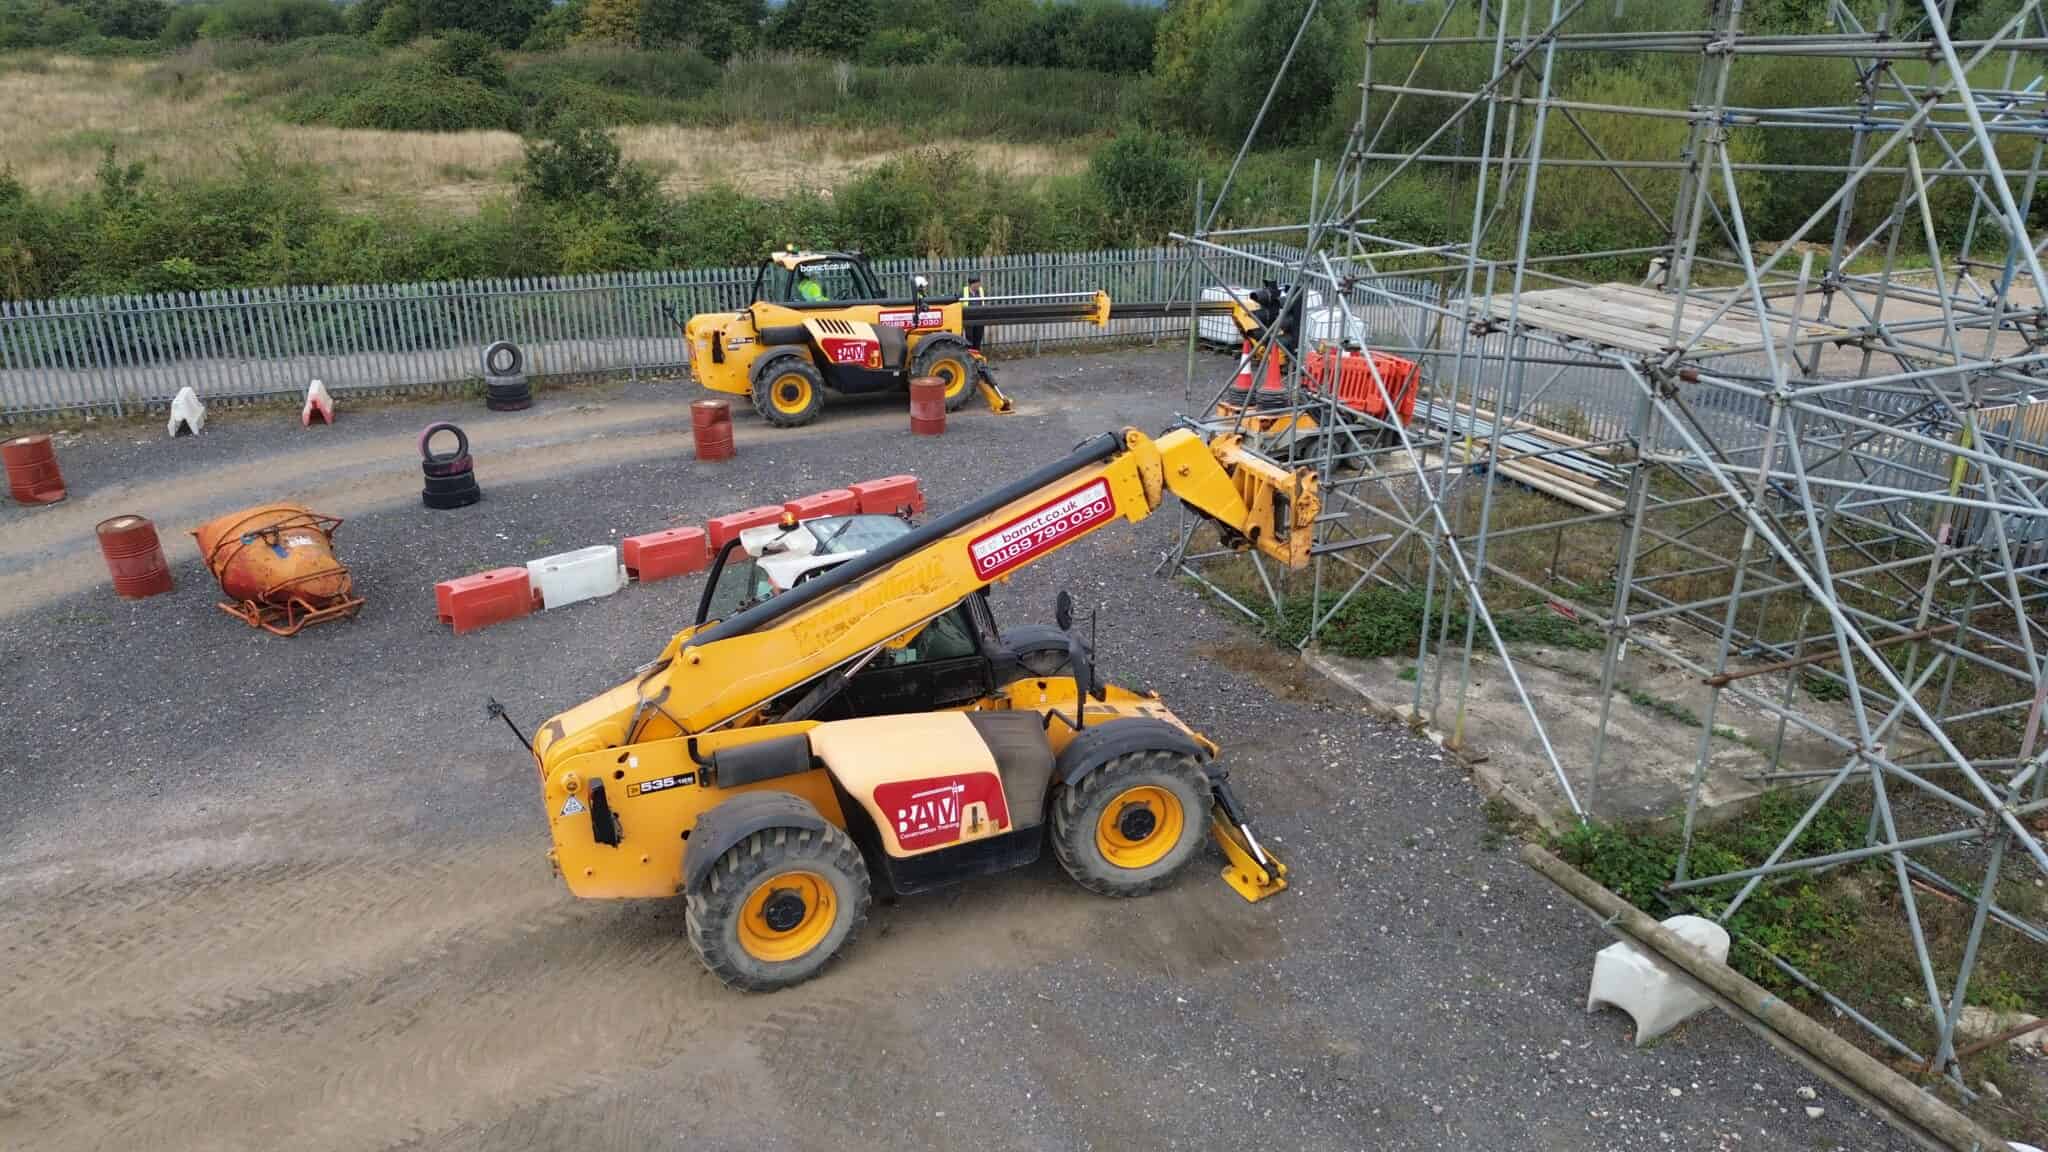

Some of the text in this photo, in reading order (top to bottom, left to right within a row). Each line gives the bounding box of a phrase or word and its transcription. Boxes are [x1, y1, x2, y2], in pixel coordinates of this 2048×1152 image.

[983, 501, 1106, 568] 01189 790 030
[1002, 500, 1078, 543] bamct.co.uk
[898, 797, 958, 832] BAM
